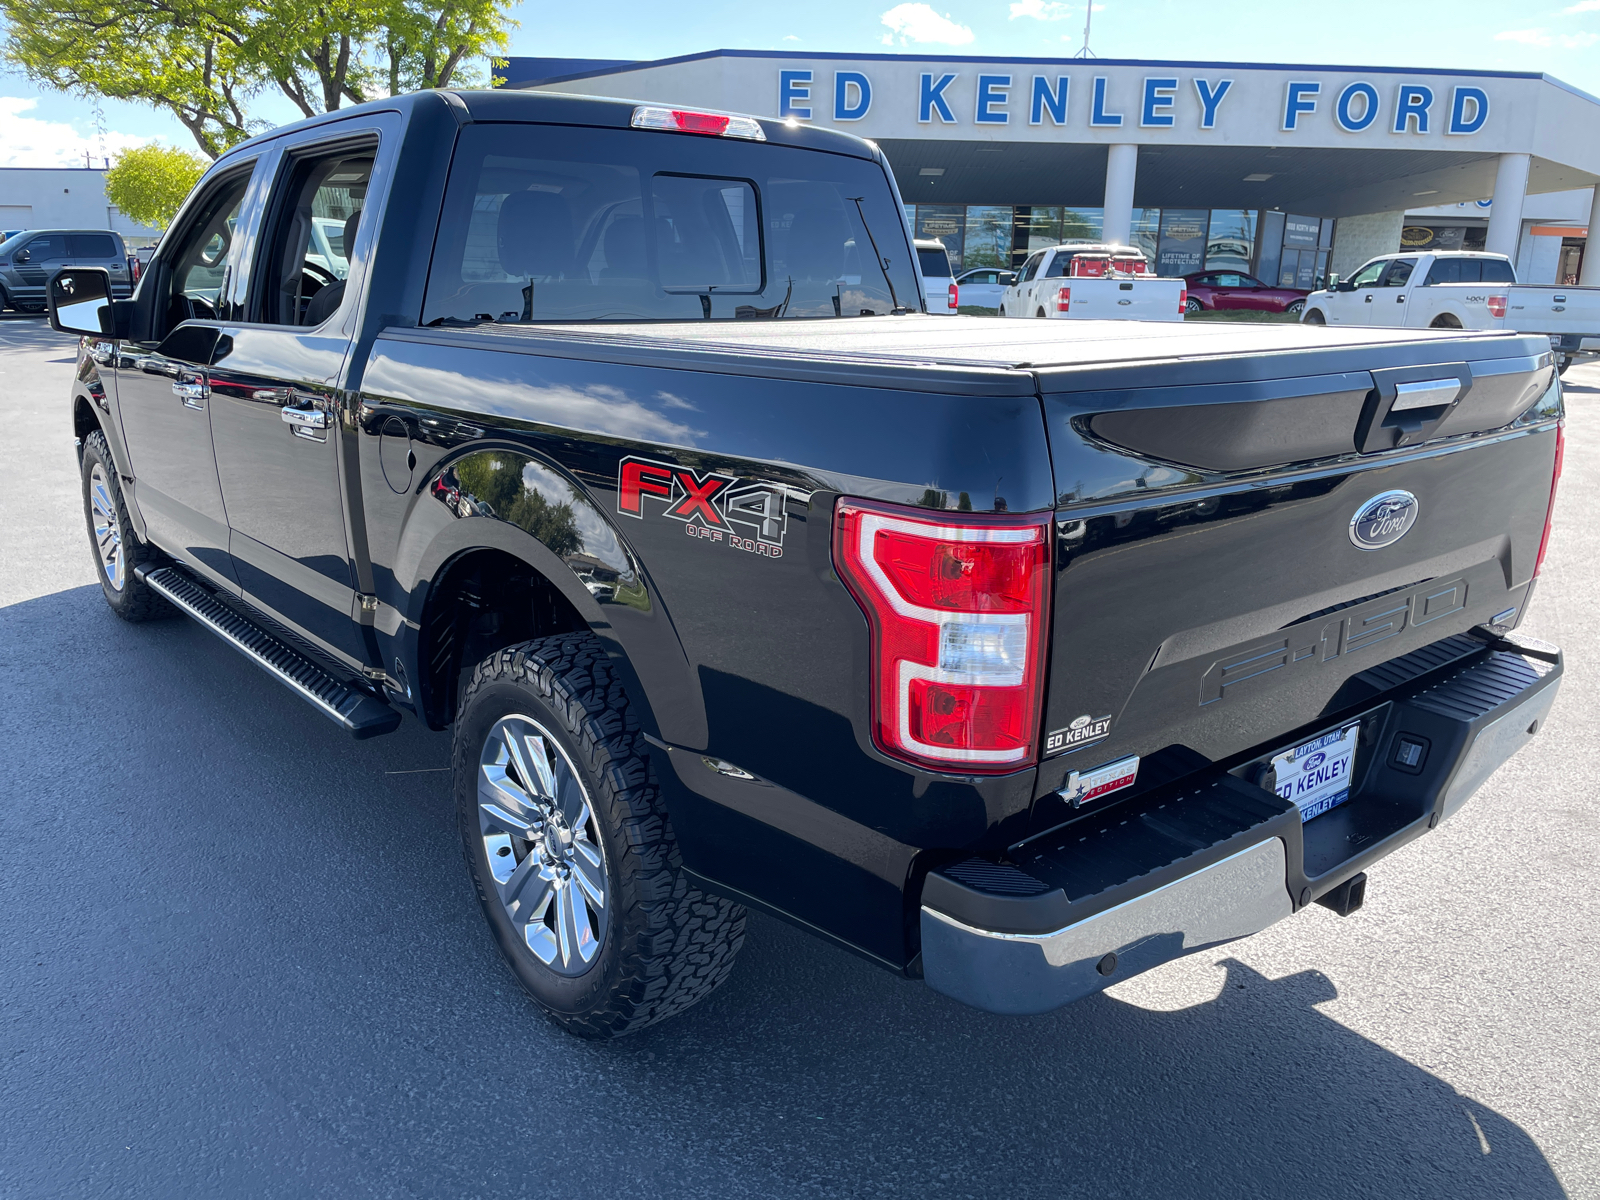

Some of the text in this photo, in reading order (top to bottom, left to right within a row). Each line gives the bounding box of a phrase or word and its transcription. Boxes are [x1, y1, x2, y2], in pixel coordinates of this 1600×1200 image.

[778, 69, 1490, 136] ED KENLEY FORD
[617, 455, 788, 547] FX4
[1370, 504, 1409, 538] Ford
[686, 523, 783, 558] OFF ROAD
[1046, 720, 1111, 749] ED KENLEY
[1324, 730, 1341, 745] UTAH
[1090, 776, 1132, 795] EDITION
[1092, 765, 1135, 786] TEXAS
[1296, 756, 1349, 795] KENLEY
[1301, 796, 1335, 822] KENLEY
